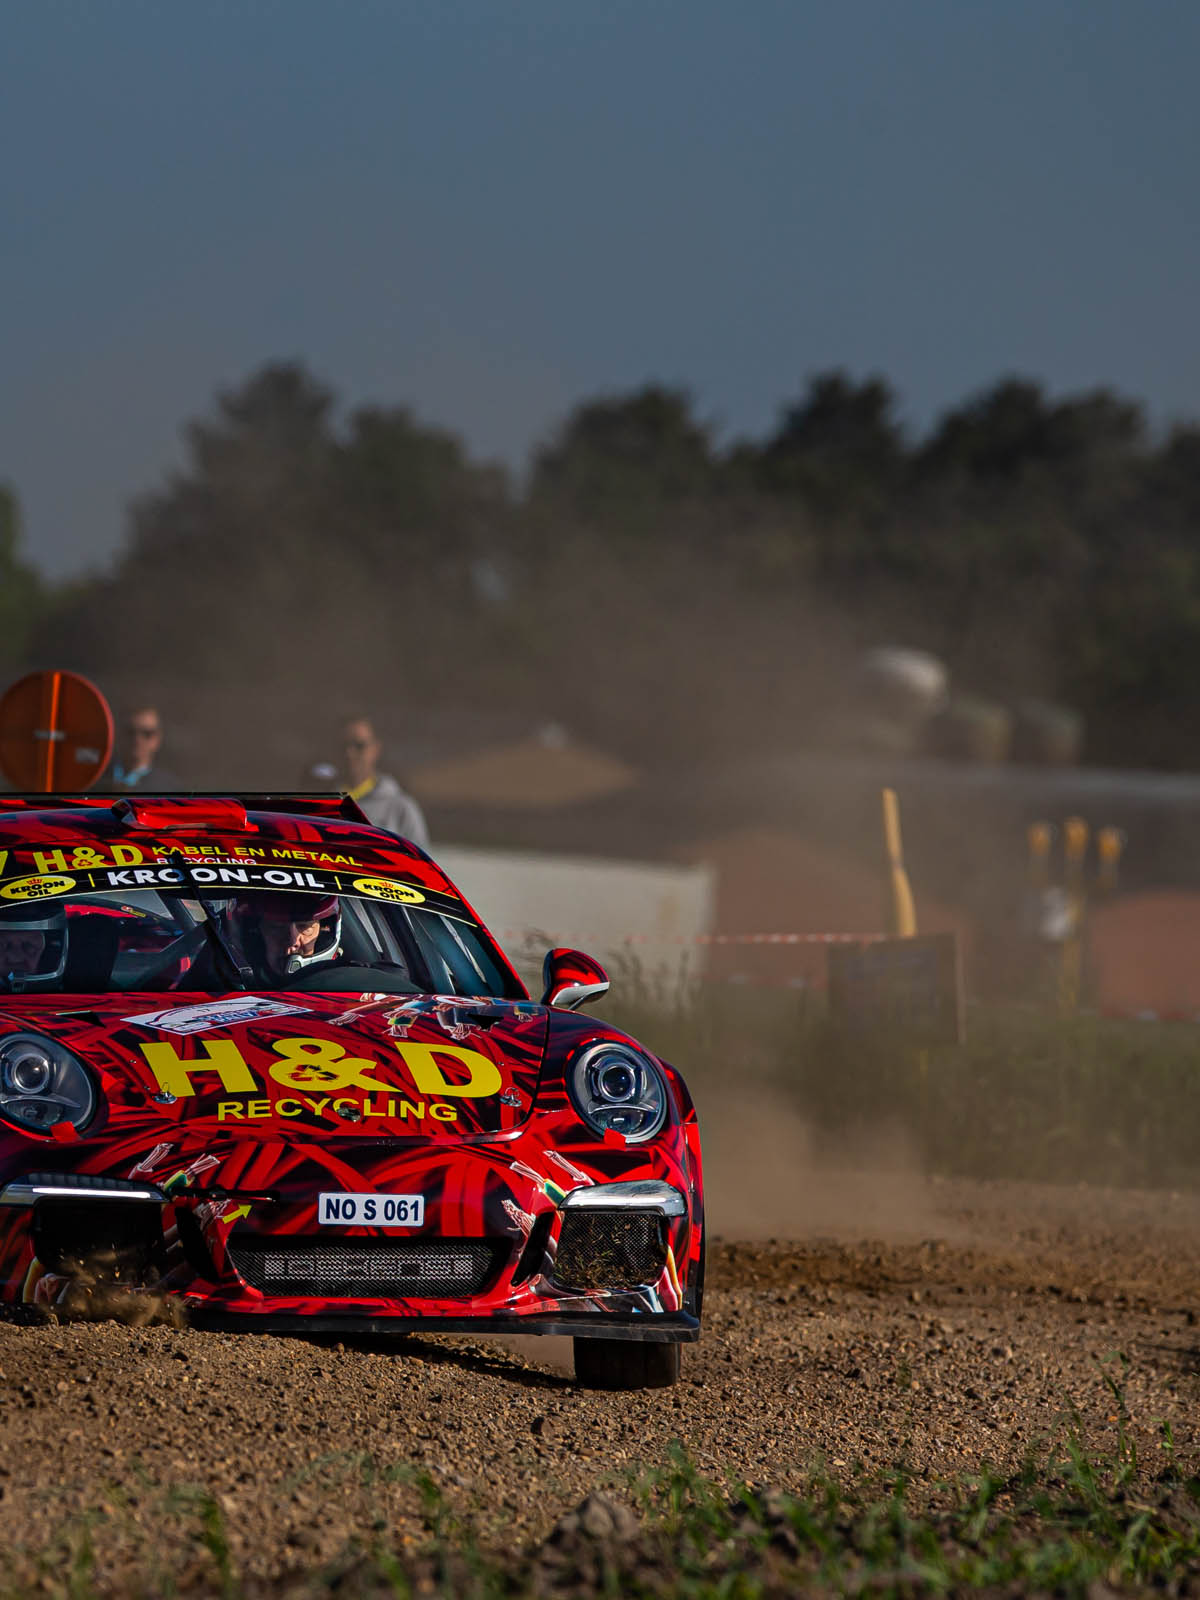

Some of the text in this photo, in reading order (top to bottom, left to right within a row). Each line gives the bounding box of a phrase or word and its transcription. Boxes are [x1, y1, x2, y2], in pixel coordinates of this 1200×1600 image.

[32, 843, 144, 874] H&D
[152, 846, 363, 867] KABEL EN METAAL
[156, 857, 257, 865] RCYCLING
[9, 880, 66, 895] KROON
[106, 867, 325, 889] KROON-OIL
[26, 888, 52, 898] OIL
[362, 883, 416, 899] KROON
[379, 892, 403, 901] OIL
[139, 1037, 502, 1097] H&D
[217, 1098, 458, 1122] RECYCLING
[325, 1198, 419, 1222] NO S 061
